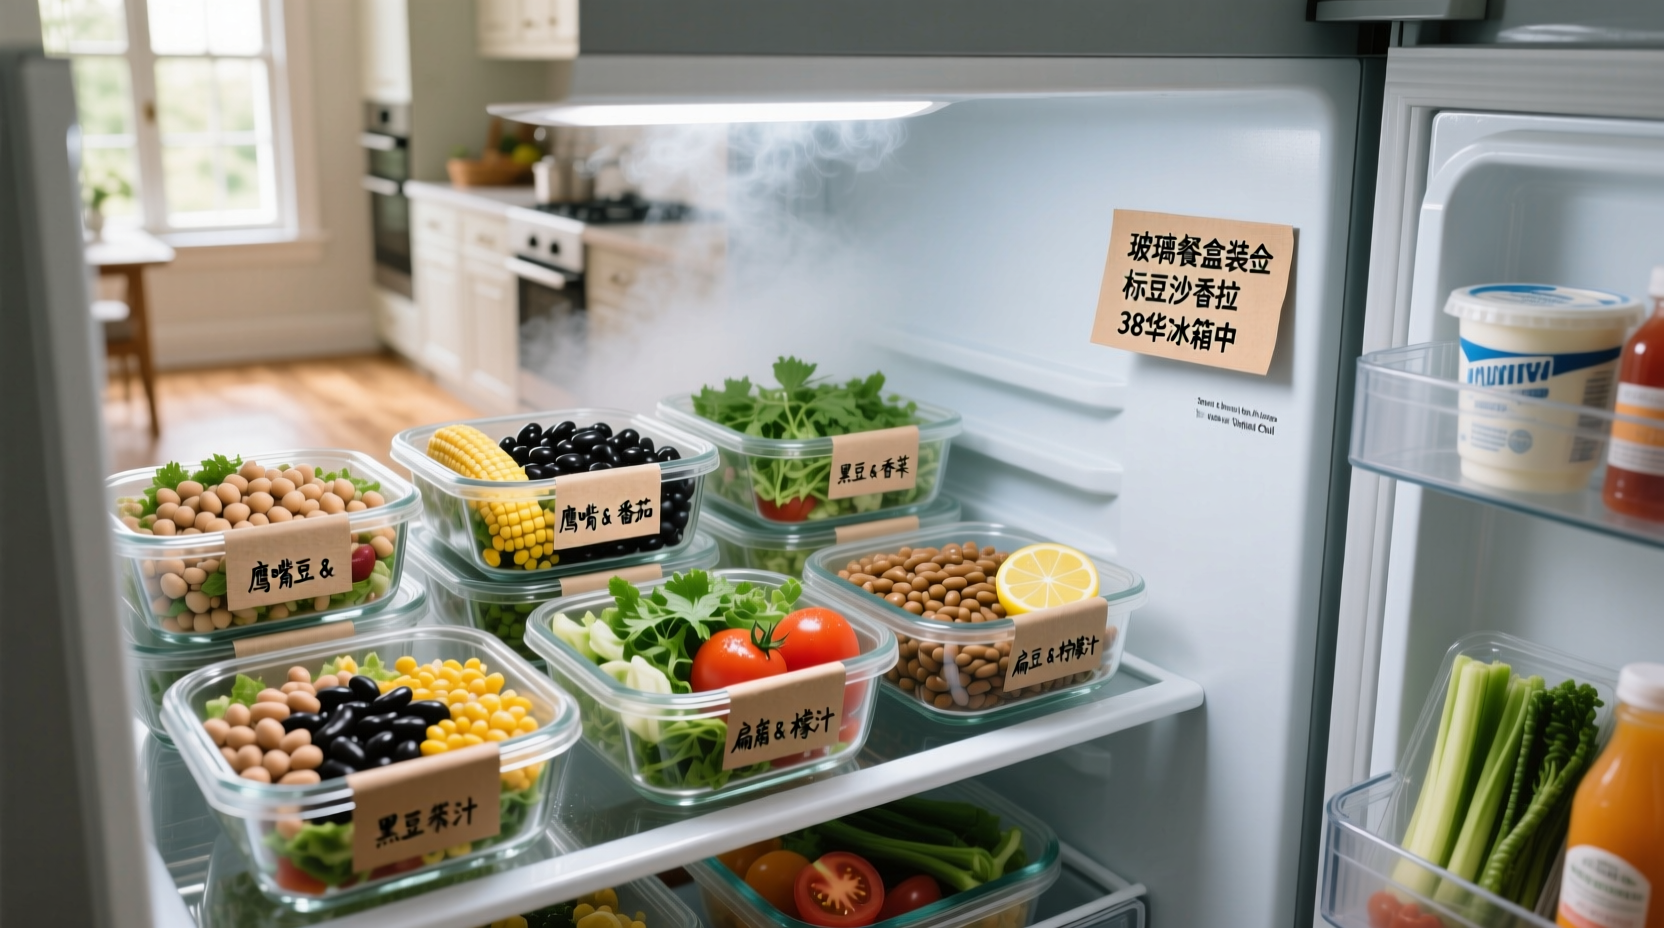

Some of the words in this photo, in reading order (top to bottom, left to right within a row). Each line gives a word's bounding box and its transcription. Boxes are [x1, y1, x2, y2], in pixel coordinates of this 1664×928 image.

[1121, 268, 1241, 310] 标豆沙香拉
[1117, 310, 1237, 354] 38华冰箱中
[319, 558, 335, 579] &
